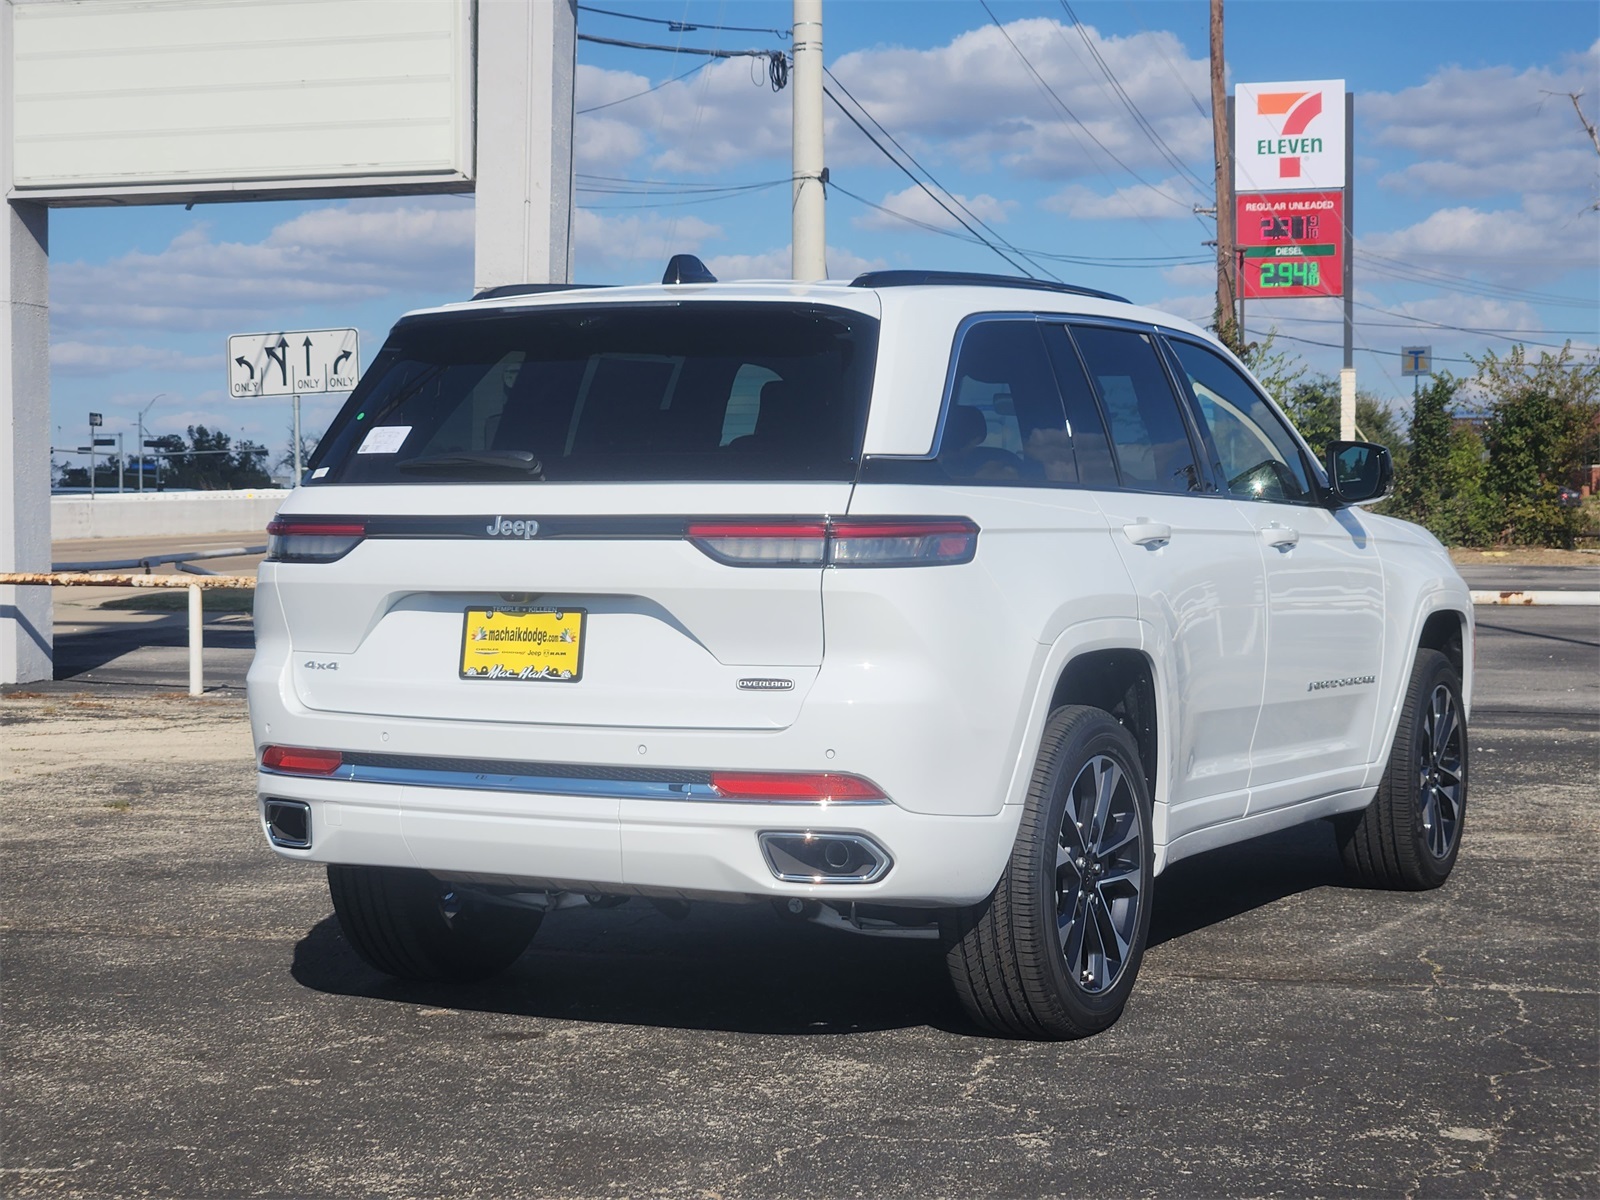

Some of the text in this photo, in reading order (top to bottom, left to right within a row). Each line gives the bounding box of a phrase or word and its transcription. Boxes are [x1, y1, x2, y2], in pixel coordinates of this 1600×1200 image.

[1257, 91, 1323, 178] 7
[1245, 200, 1335, 211] REGULAR UNLEADED
[1275, 246, 1303, 256] DIESEL
[234, 382, 258, 393] ONLY
[297, 379, 320, 389] ONLY
[330, 377, 354, 388] ONLY
[486, 515, 540, 539] Jeep
[488, 626, 559, 646] machaikdodge.com
[304, 660, 339, 671] 4x4
[488, 664, 551, 680] Mac Haik
